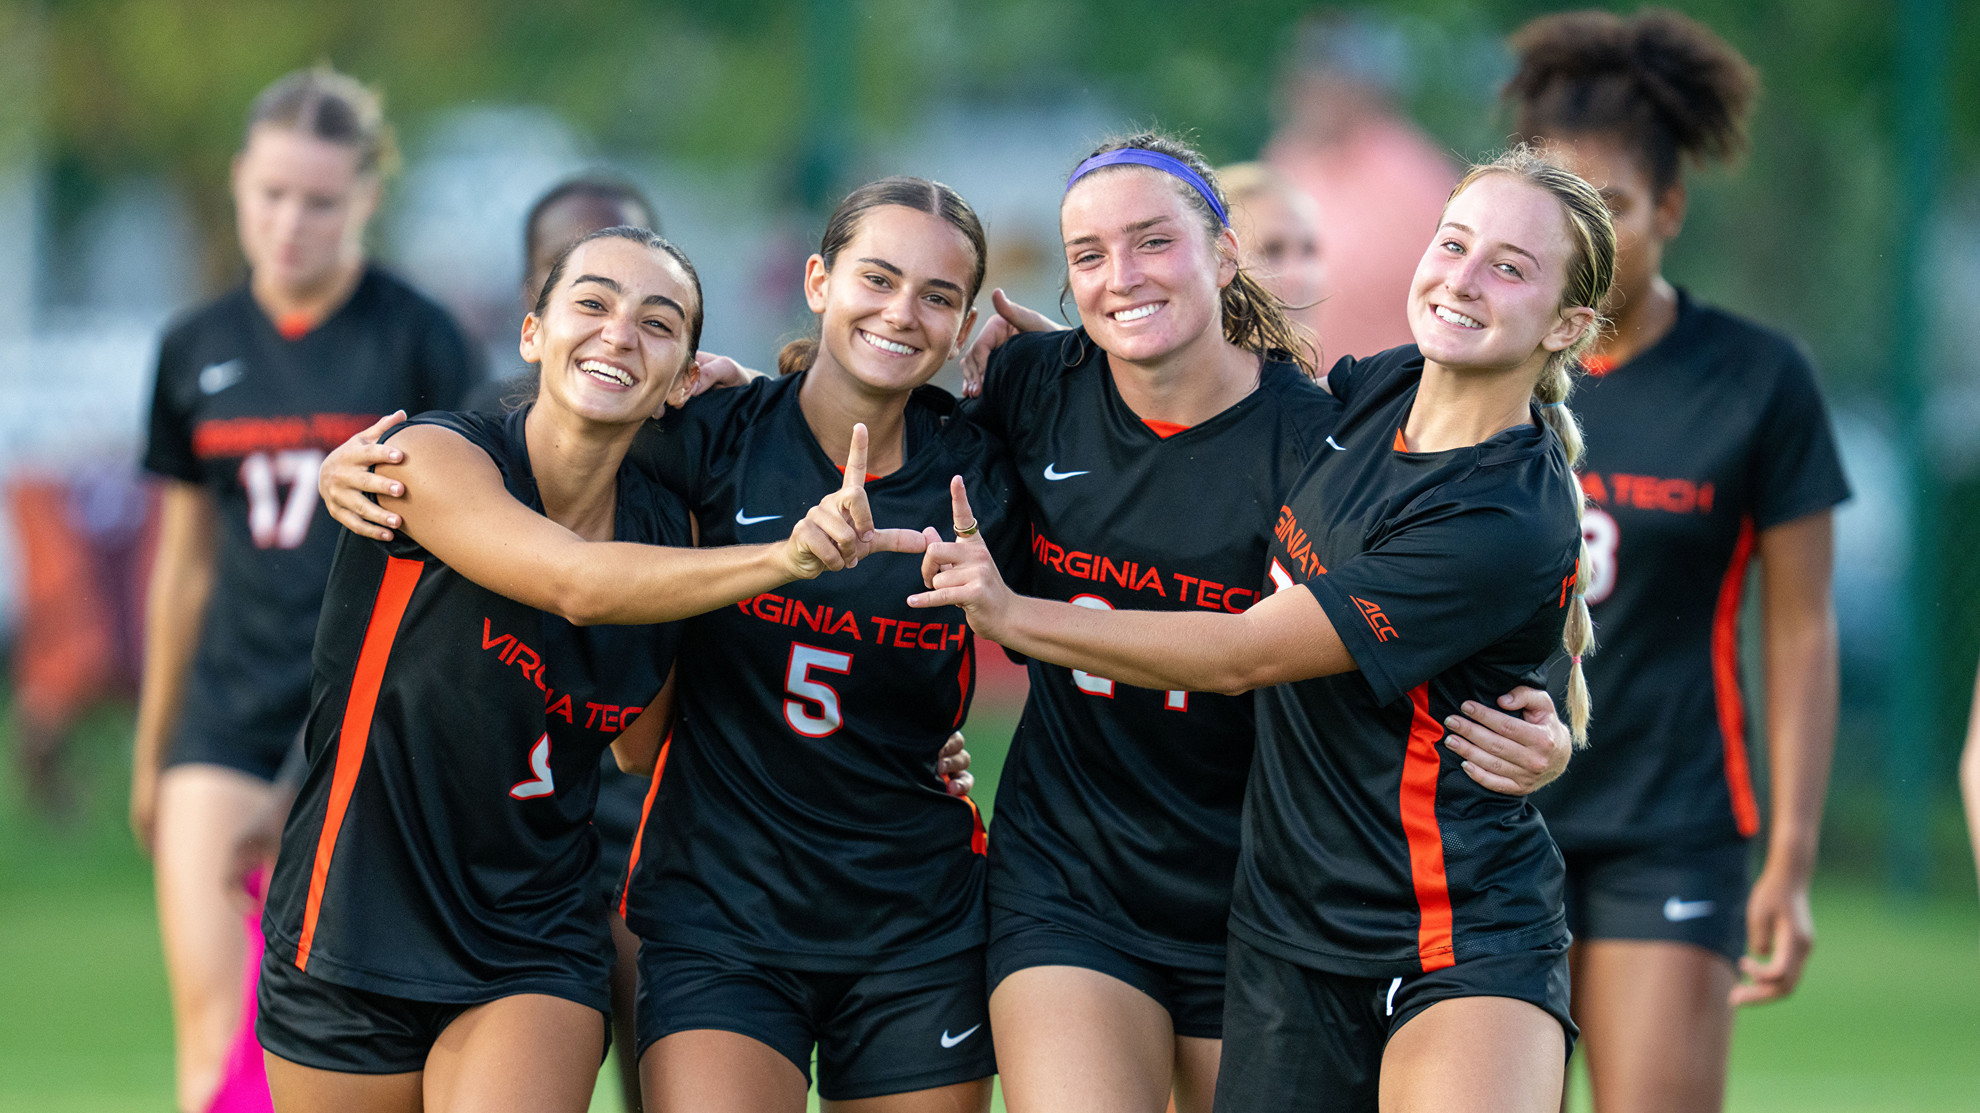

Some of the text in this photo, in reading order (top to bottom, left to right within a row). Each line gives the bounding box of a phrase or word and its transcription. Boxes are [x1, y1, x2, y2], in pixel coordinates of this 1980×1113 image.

[239, 449, 326, 549] 17
[1031, 521, 1167, 598] VIRGINIA
[1274, 504, 1312, 574] GINIA
[736, 592, 966, 651] GINIA TECH
[1356, 597, 1399, 642] ACC
[482, 616, 643, 733] VIRIA TEC
[783, 640, 854, 738] 5
